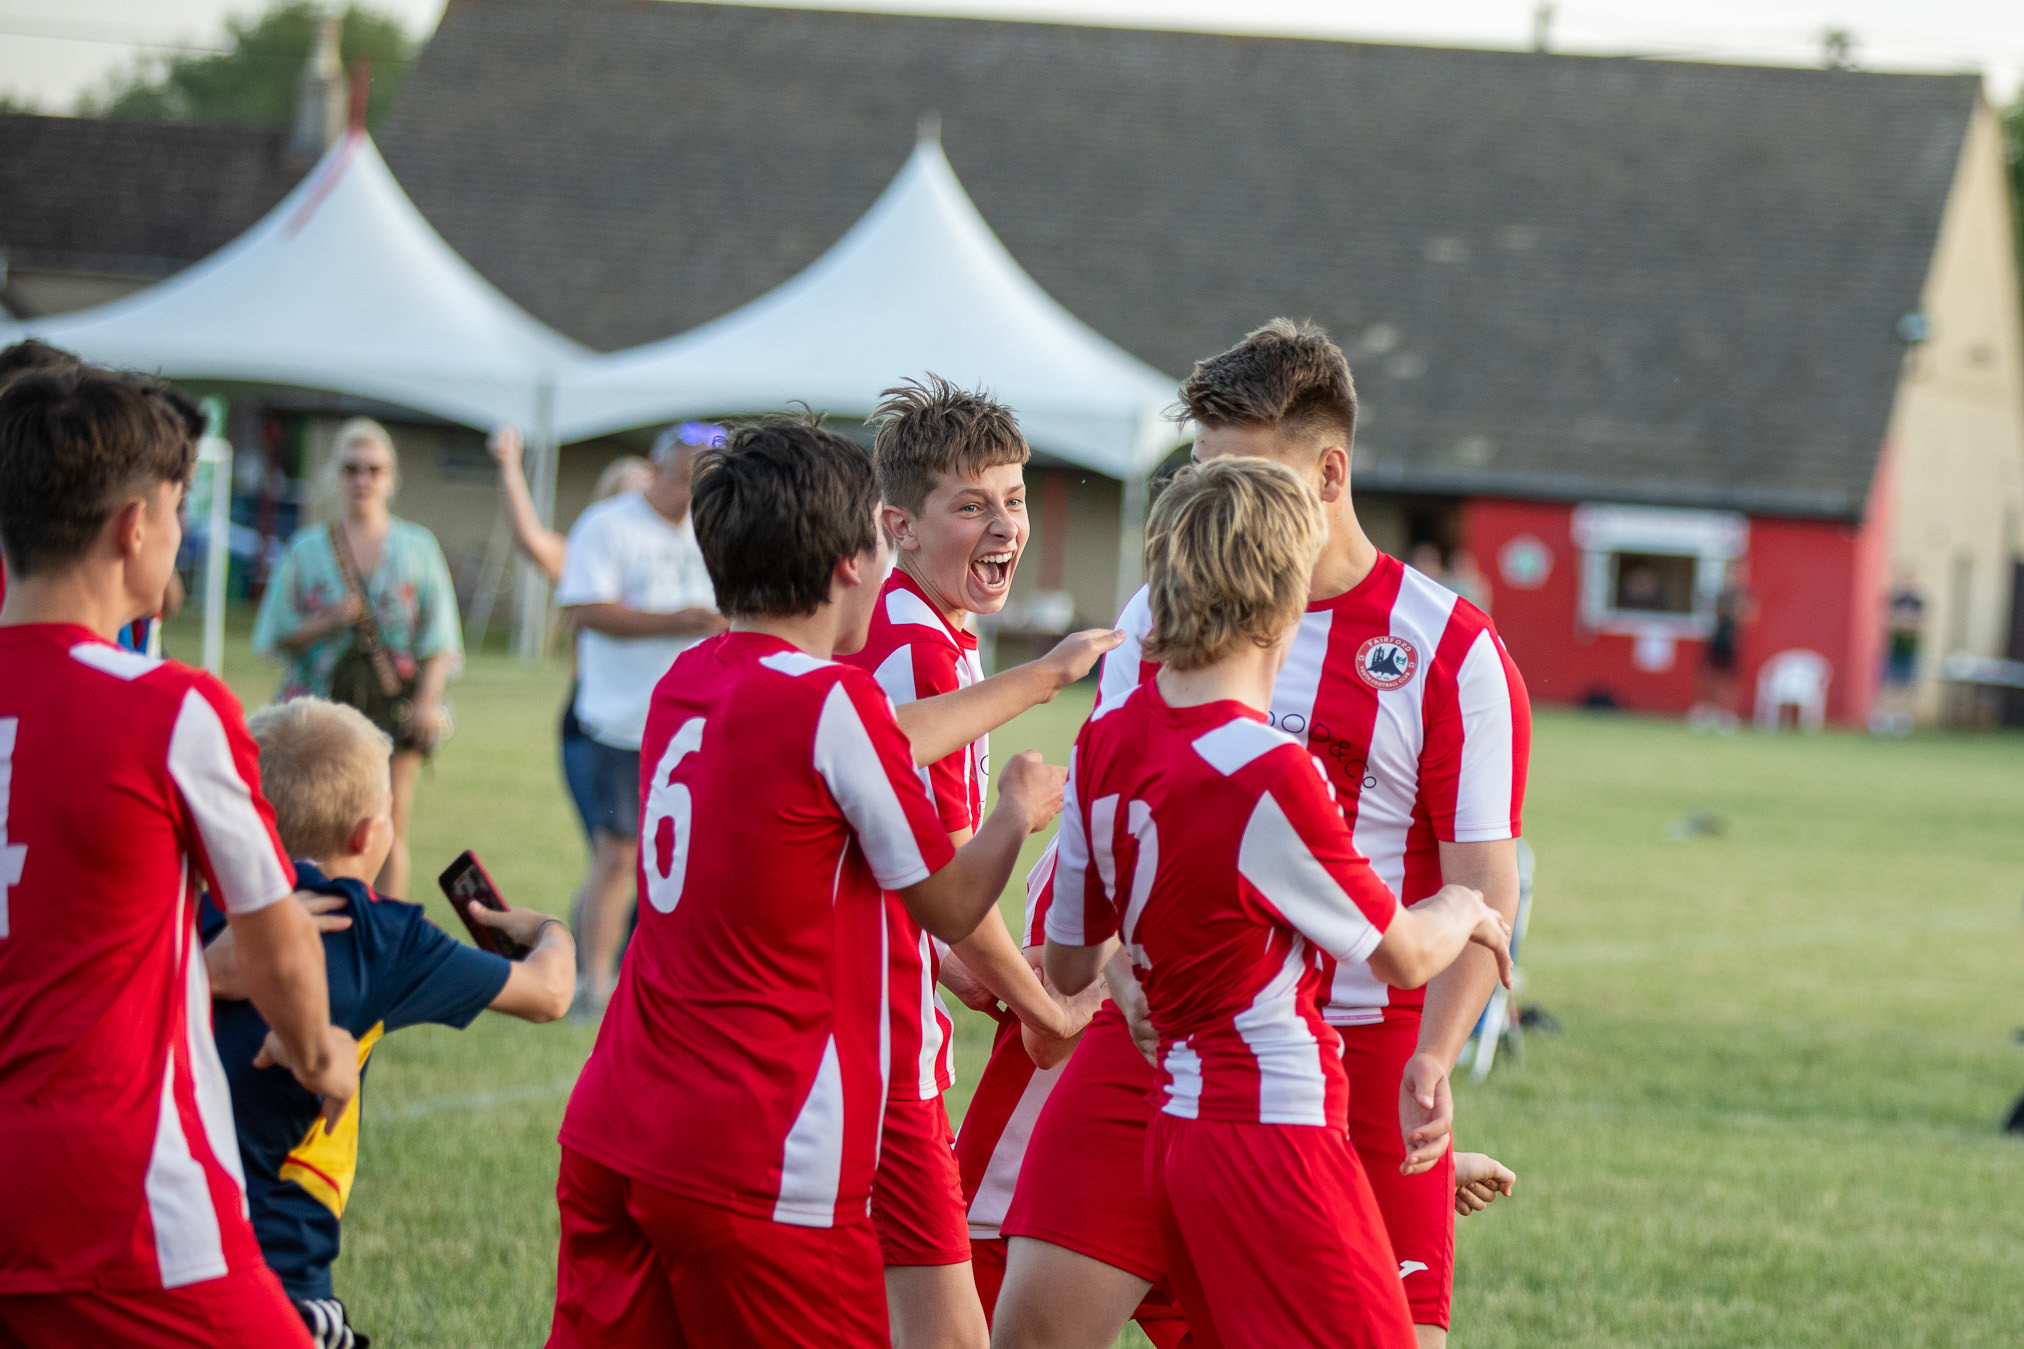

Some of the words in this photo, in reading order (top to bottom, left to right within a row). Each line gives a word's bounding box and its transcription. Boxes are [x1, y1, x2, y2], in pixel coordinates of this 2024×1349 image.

[1367, 637, 1412, 652] FAIRFORD
[1359, 665, 1371, 681] YOUTH
[1371, 679, 1398, 688] FOOTBALL
[1398, 672, 1411, 684] CLUB
[1329, 740, 1352, 763] &
[642, 716, 707, 915] 6
